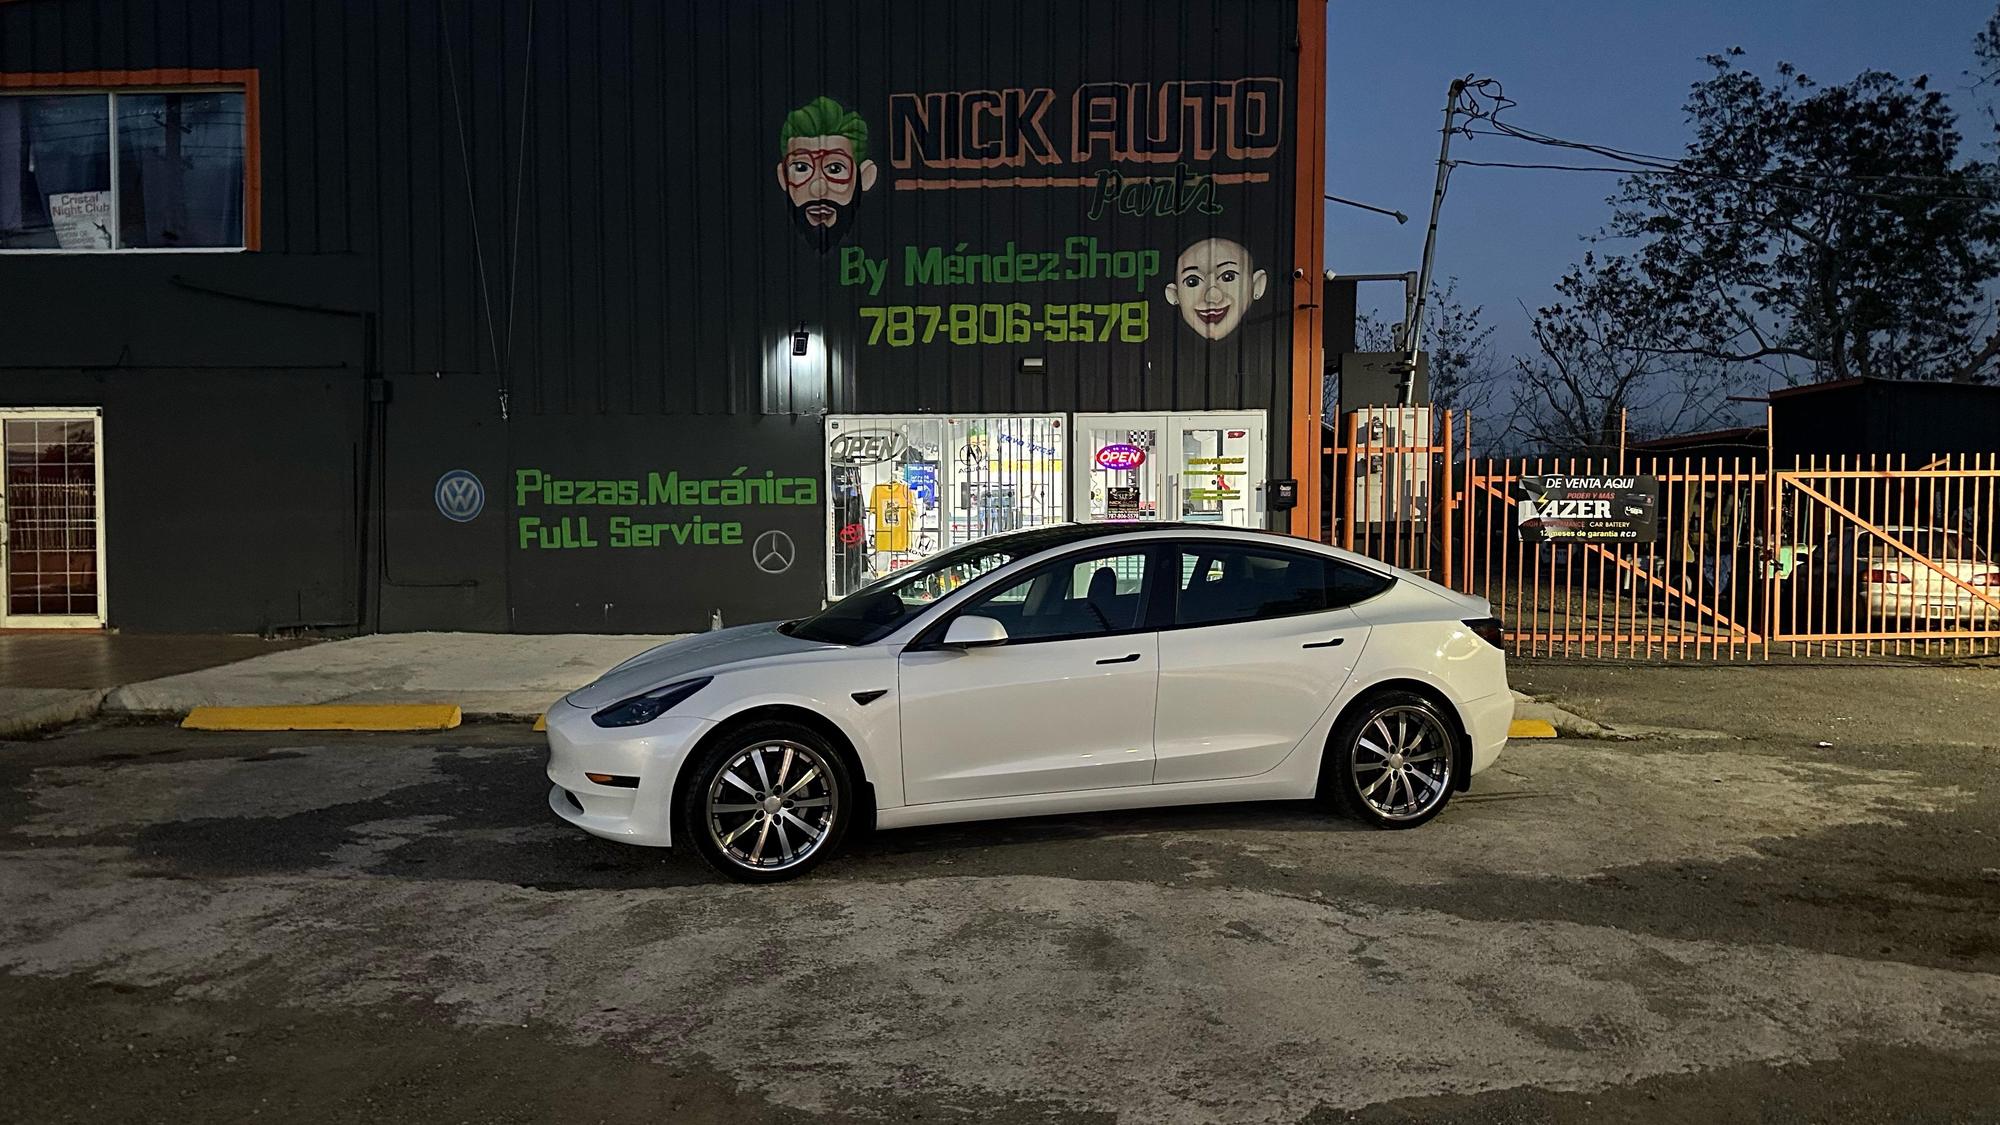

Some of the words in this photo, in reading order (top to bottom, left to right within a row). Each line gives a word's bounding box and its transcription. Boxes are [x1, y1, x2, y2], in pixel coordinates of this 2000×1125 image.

[889, 88, 1062, 168] NICK
[1071, 77, 1284, 162] AUTO
[52, 206, 82, 217] Night
[85, 203, 110, 213] Club
[61, 194, 99, 205] Cristal
[840, 246, 889, 296] By
[904, 242, 1059, 286] Méndez
[859, 301, 1150, 347] 787-806-5578
[831, 436, 899, 459] OPEN
[1100, 451, 1141, 463] OPEN
[1546, 478, 1562, 488] DE
[1566, 478, 1601, 488] VENTA
[1603, 478, 1634, 489] AQUI
[1519, 500, 1612, 519] LAZER
[610, 515, 743, 547] Service
